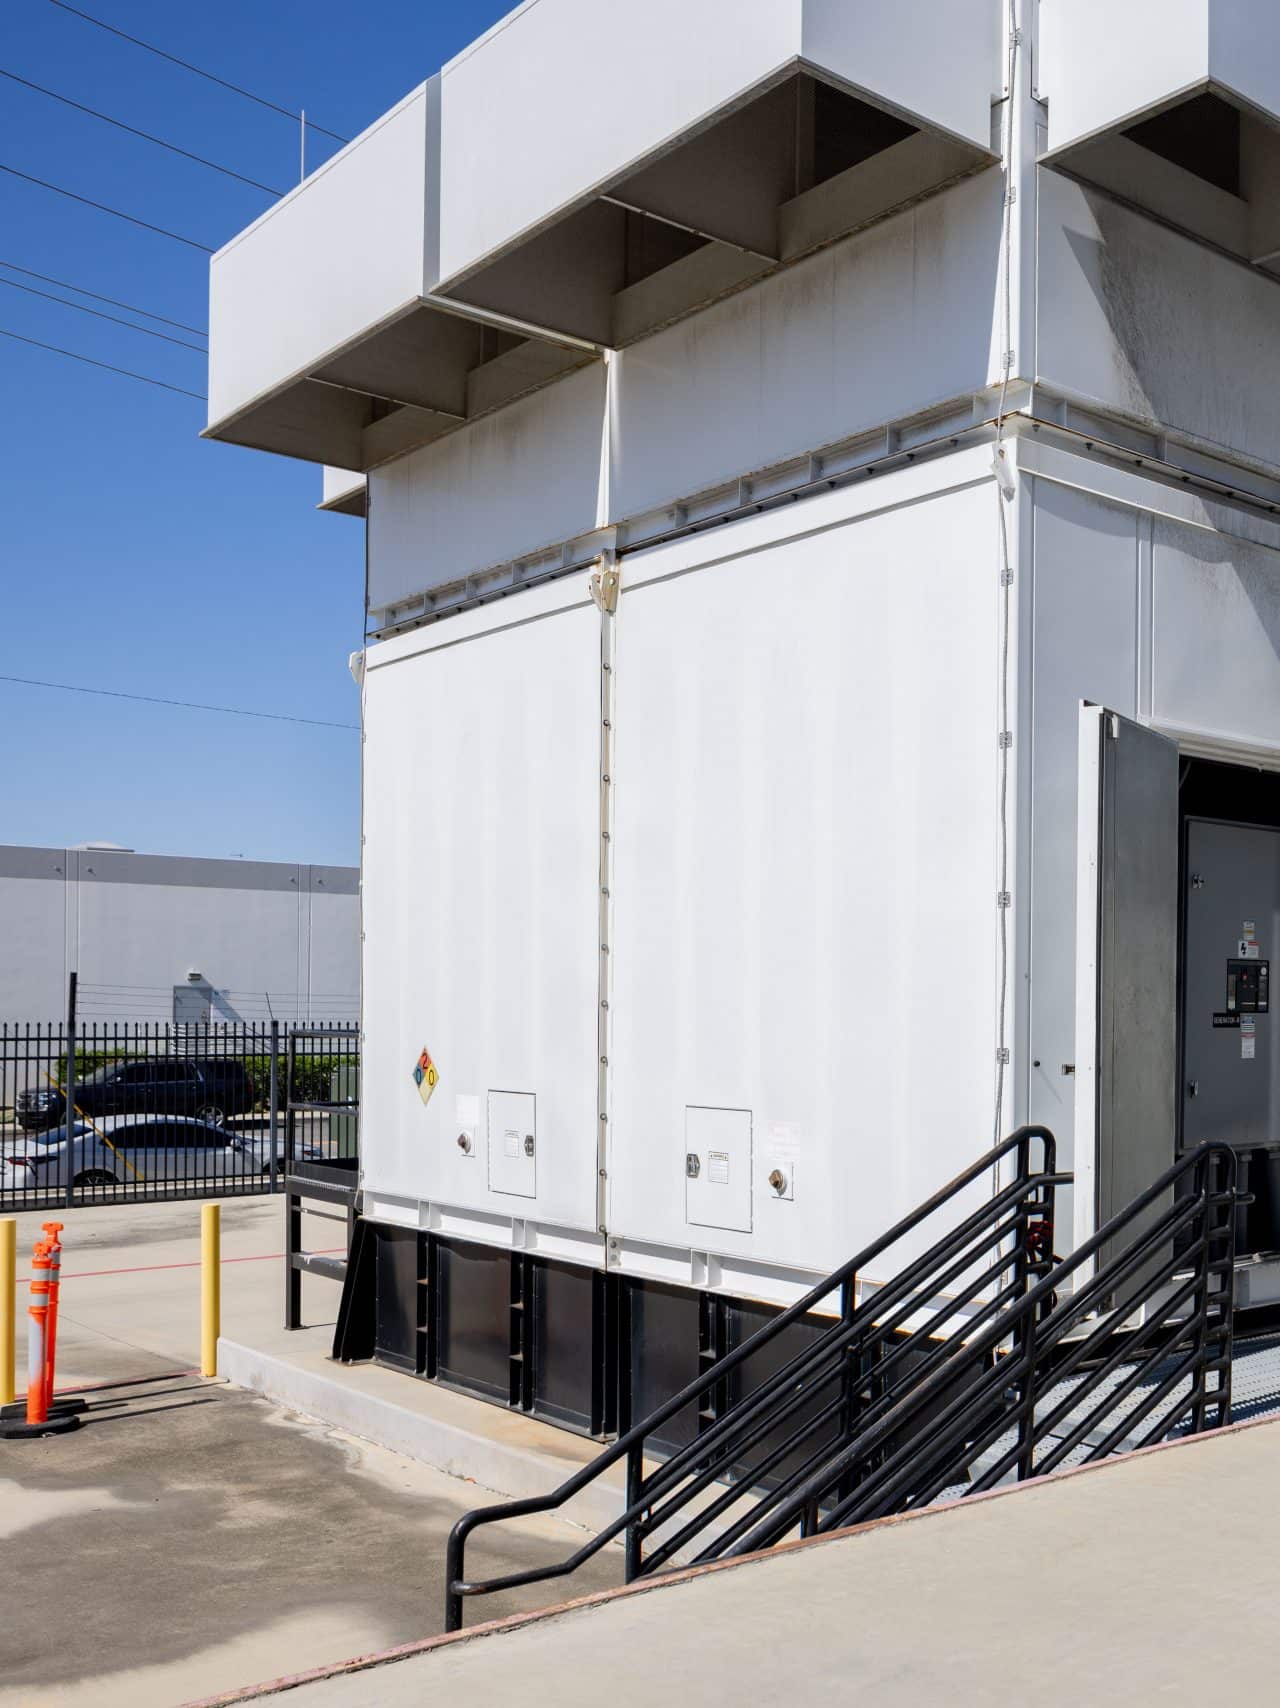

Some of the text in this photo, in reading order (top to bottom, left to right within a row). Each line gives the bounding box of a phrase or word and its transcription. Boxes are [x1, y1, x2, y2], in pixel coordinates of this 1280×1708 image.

[422, 1052, 428, 1070] 2
[416, 1068, 422, 1085] 0
[429, 1069, 434, 1086] 0
